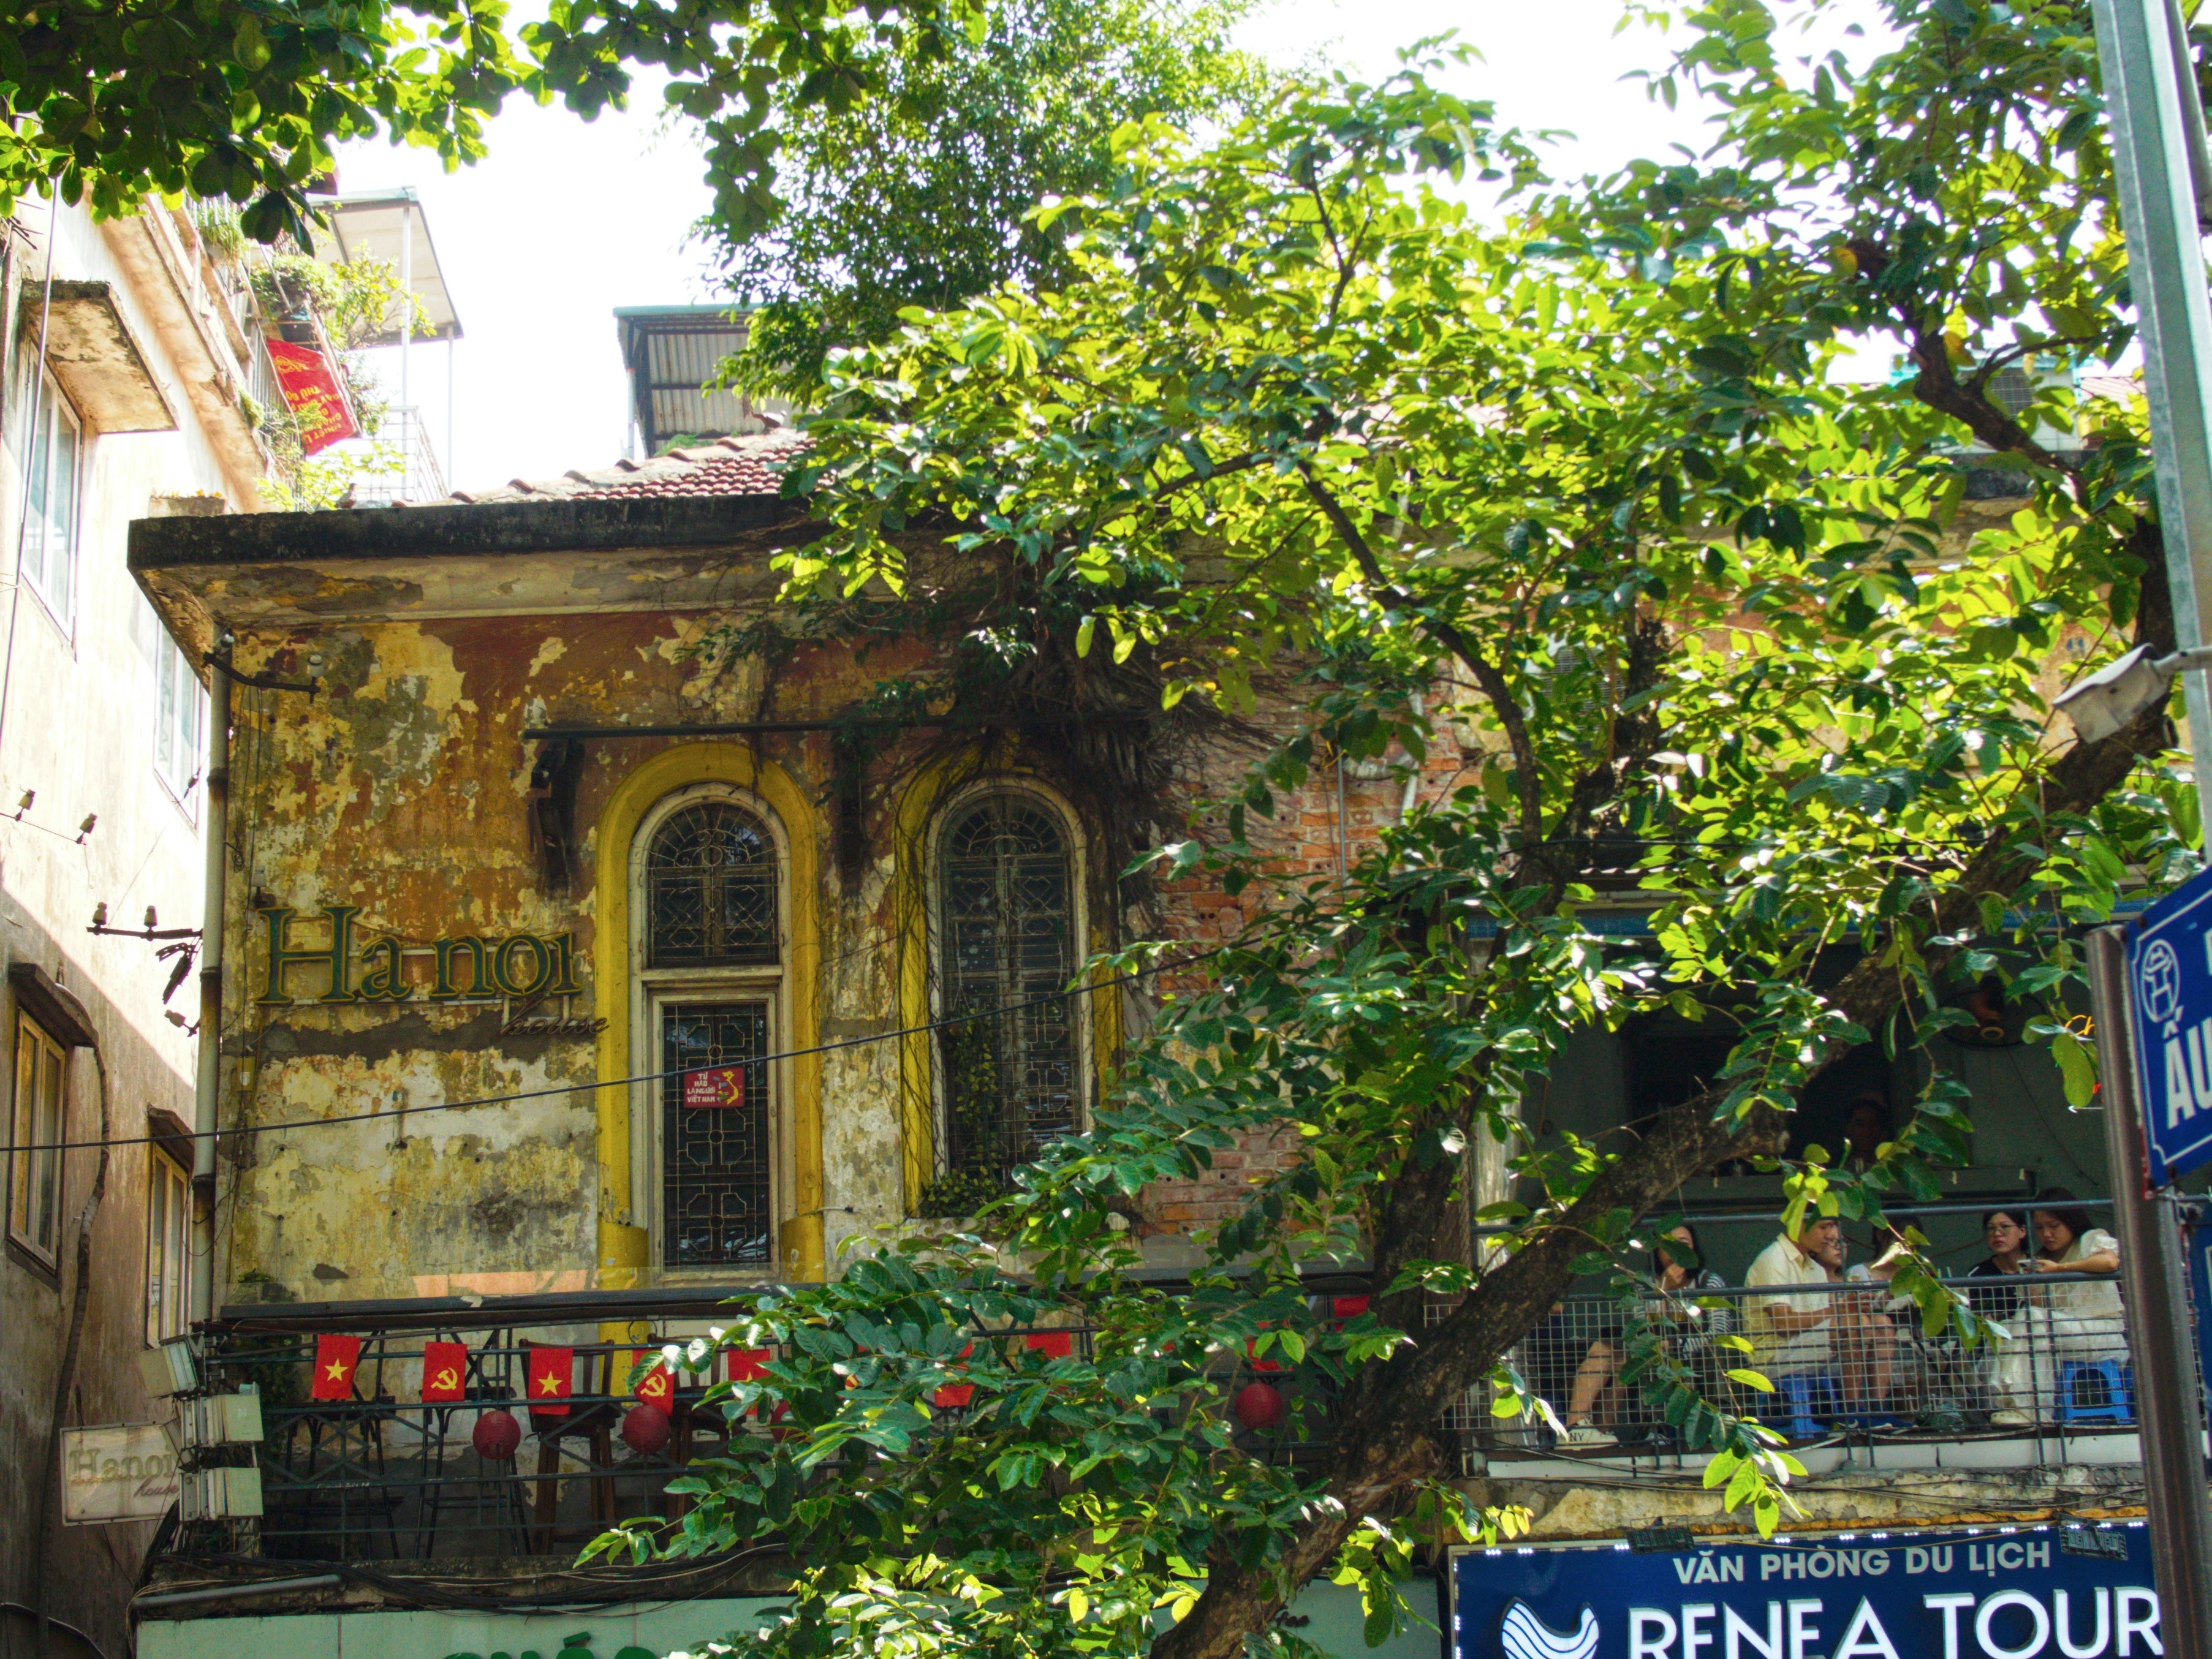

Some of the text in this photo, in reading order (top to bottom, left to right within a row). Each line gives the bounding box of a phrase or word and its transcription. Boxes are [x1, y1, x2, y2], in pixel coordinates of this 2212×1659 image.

[256, 904, 583, 1005] Hanoi
[499, 994, 610, 1035] house
[1673, 1541, 2050, 1584] VĂN PHÒNG DU LỊCH
[1923, 1586, 2165, 1659] TOUR
